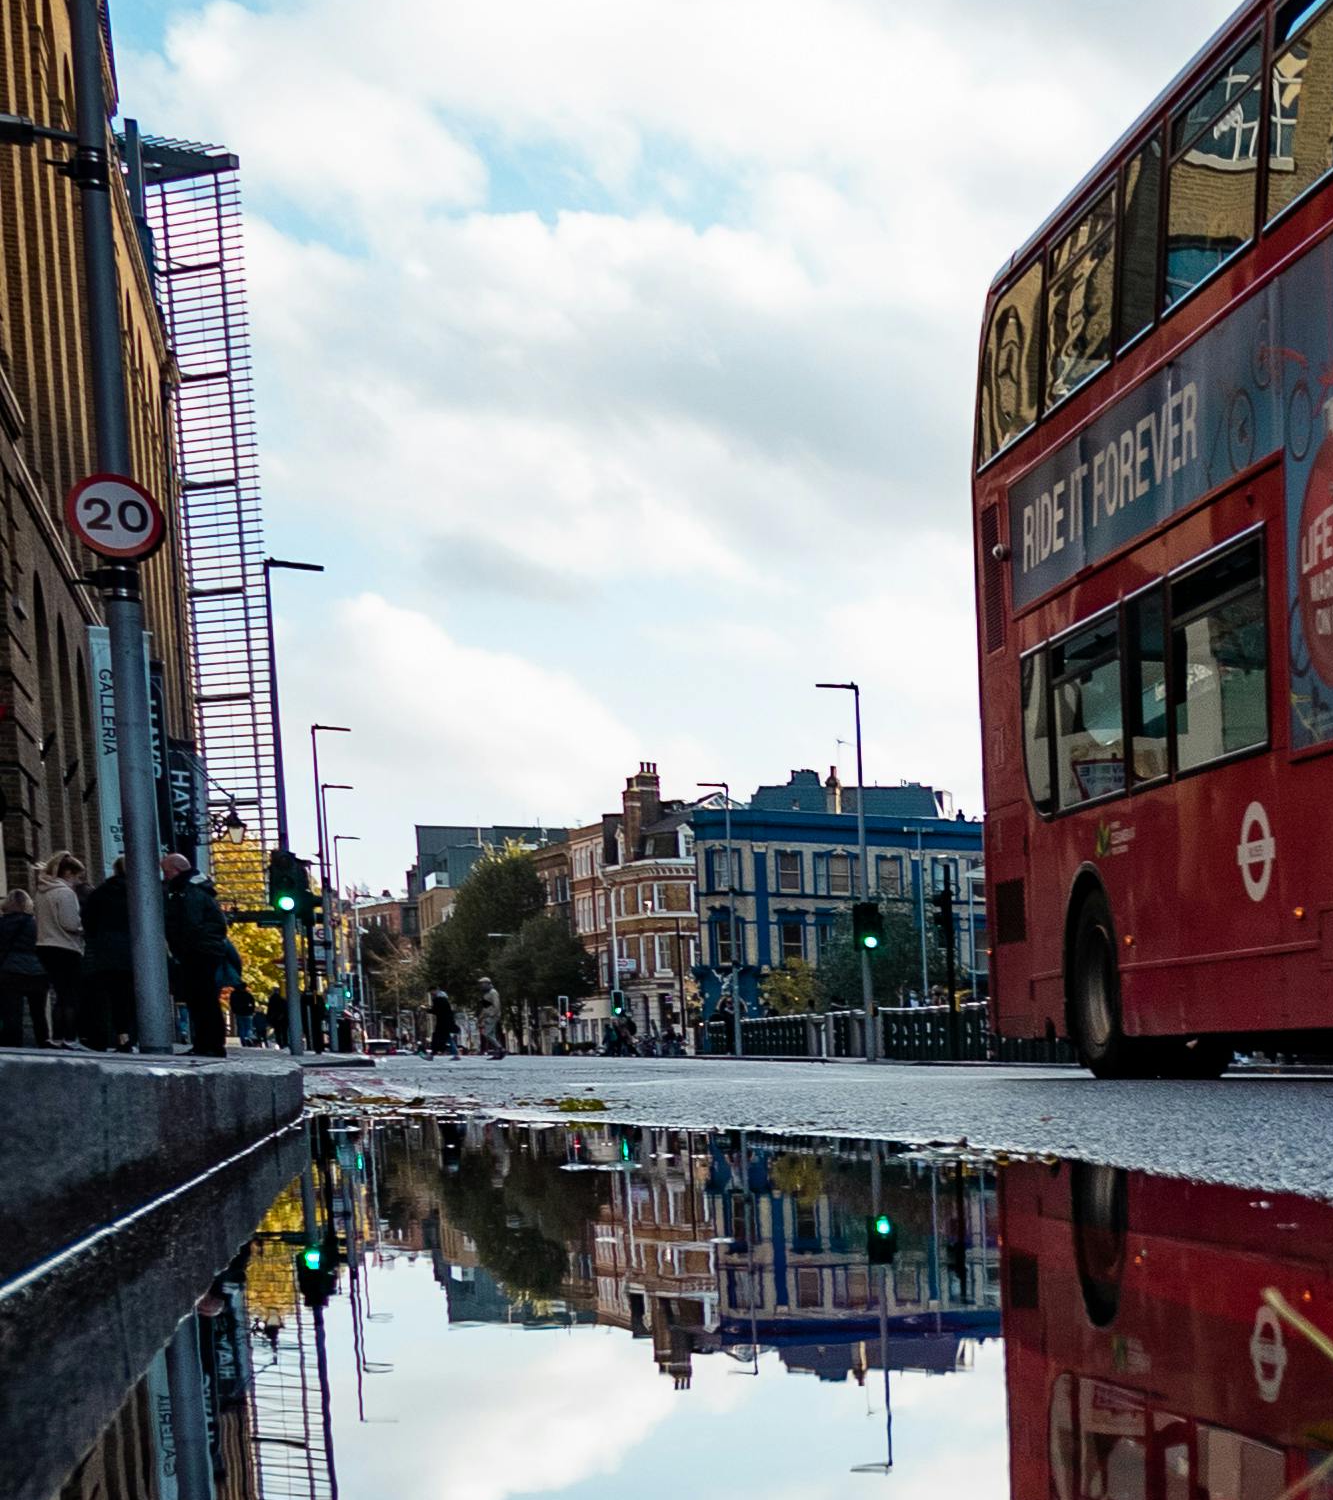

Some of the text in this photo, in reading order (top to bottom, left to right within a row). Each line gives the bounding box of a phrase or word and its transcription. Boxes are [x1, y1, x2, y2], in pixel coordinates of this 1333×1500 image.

[83, 498, 149, 533] 20
[1023, 381, 1197, 574] RIDE IT FOREVER
[99, 668, 117, 756] GALLERIA
